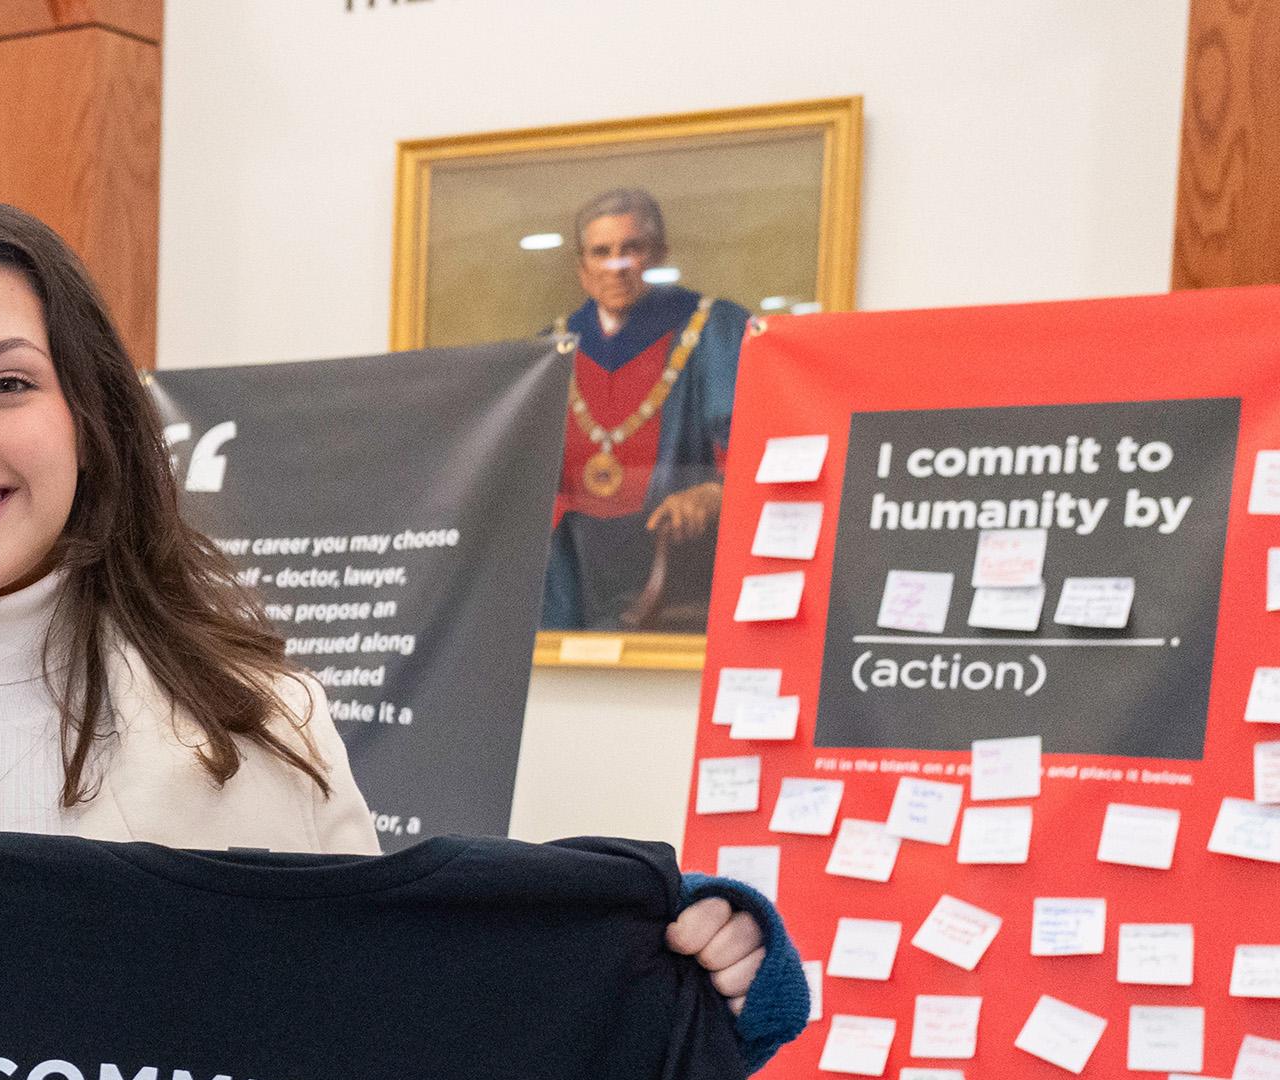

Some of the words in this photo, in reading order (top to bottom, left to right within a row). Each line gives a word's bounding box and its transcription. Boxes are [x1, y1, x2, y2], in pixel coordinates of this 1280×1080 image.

[877, 442, 892, 479] I
[907, 435, 1101, 478] commit
[1115, 436, 1173, 473] to
[870, 490, 1109, 535] humanity
[1124, 488, 1193, 534] by
[252, 537, 310, 556] career
[312, 535, 349, 557] you
[350, 534, 390, 555] may
[393, 528, 460, 550] choose
[276, 567, 340, 589] doctor,
[343, 565, 407, 588] lawyer,
[295, 602, 371, 623] propose
[373, 600, 398, 619] an
[284, 632, 360, 656] pursued
[361, 632, 416, 656] along
[852, 651, 1047, 697] (action)
[379, 702, 395, 724] it
[398, 707, 413, 725] a
[406, 816, 421, 834] a
